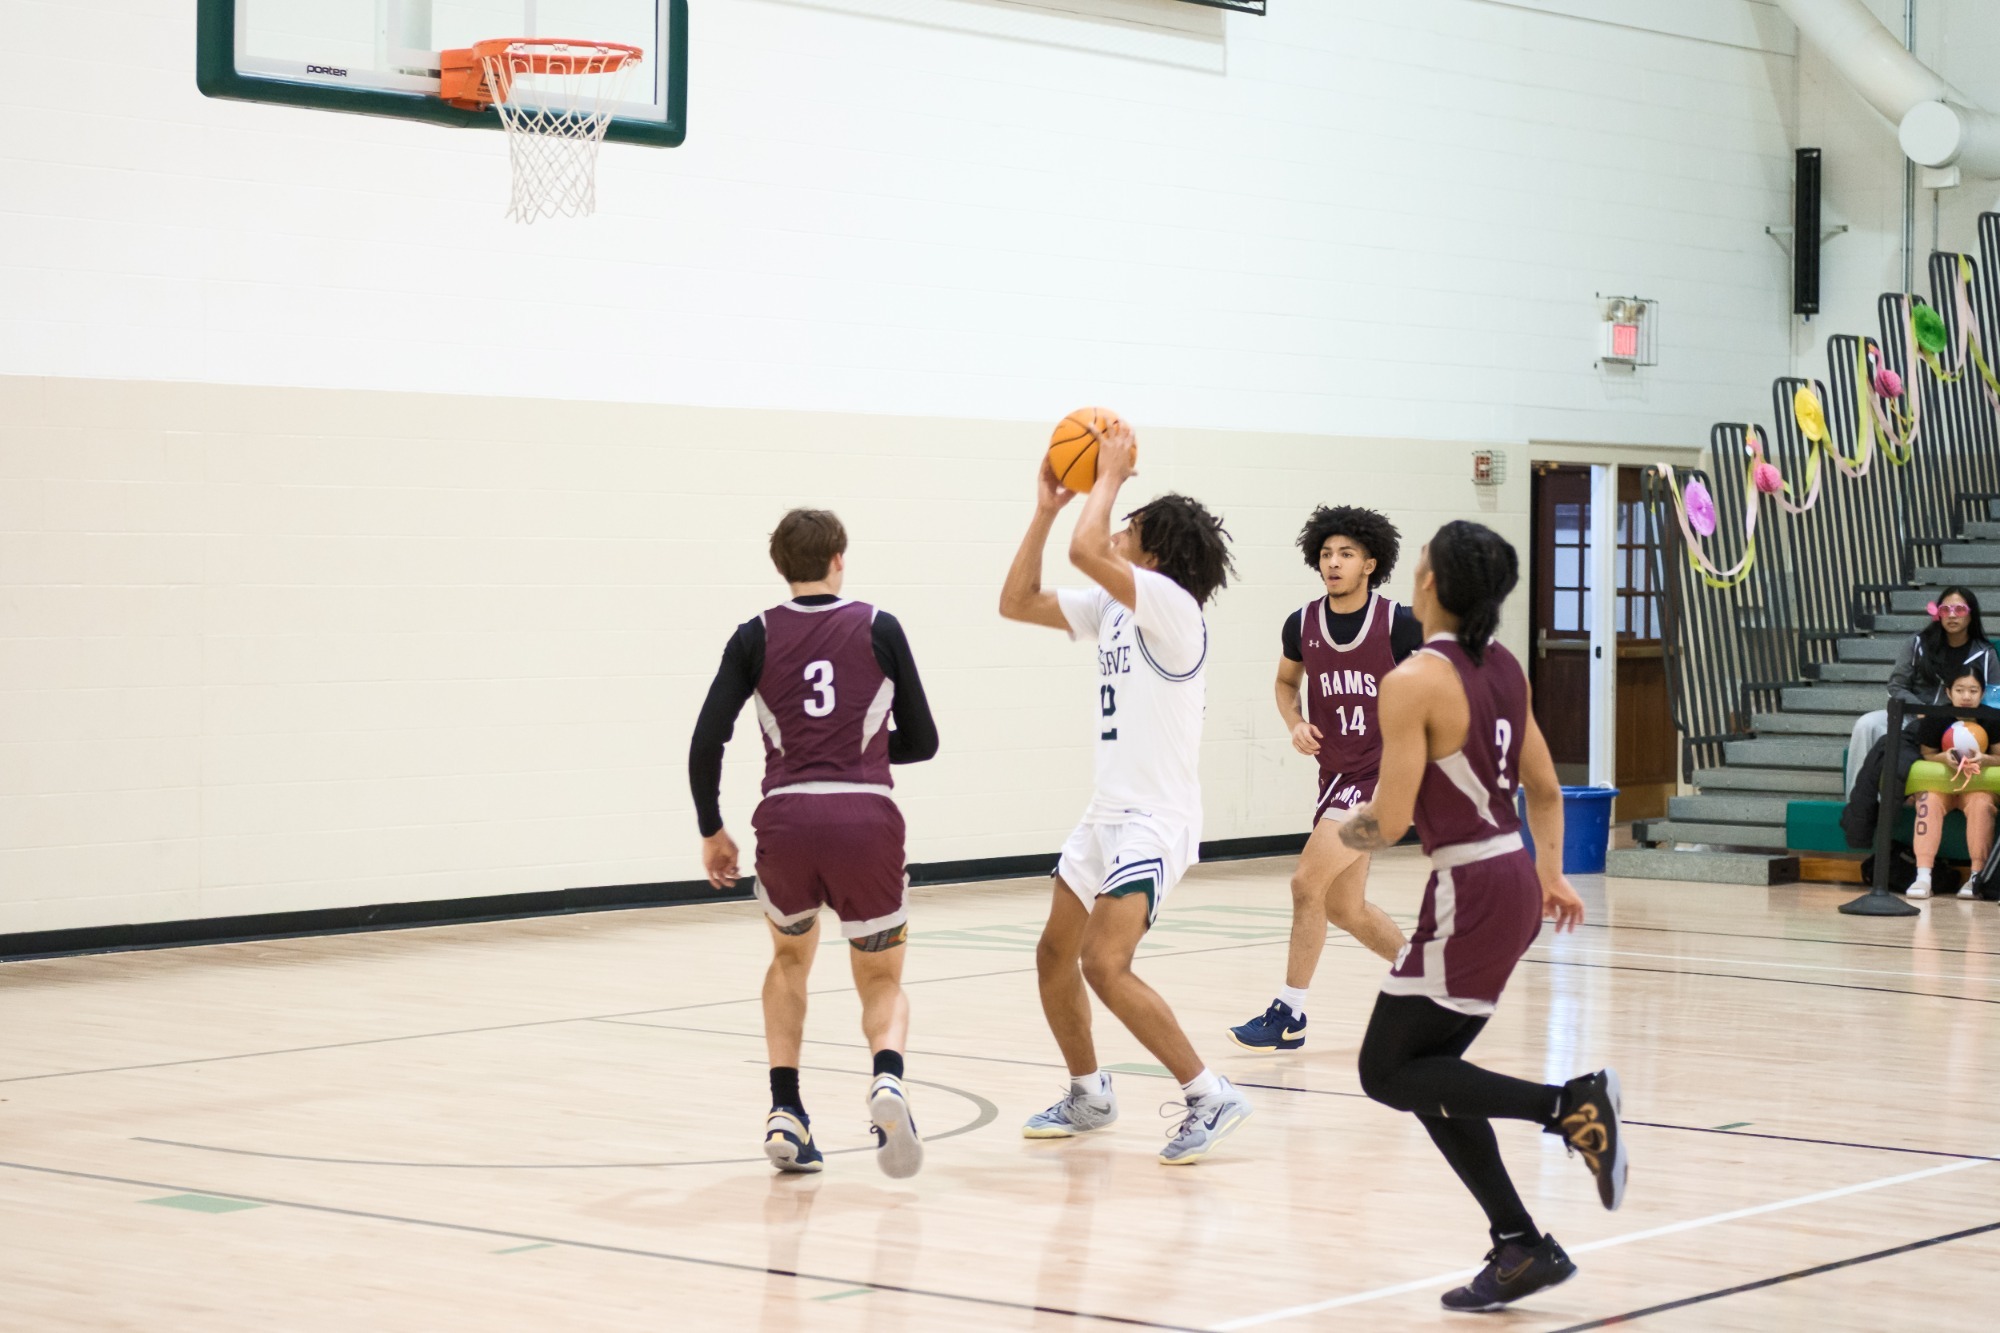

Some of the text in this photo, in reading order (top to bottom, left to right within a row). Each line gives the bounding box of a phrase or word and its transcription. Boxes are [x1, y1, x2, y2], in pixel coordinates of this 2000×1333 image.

[803, 660, 836, 718] 3
[1319, 669, 1378, 698] RAMS
[1335, 705, 1367, 736] 14
